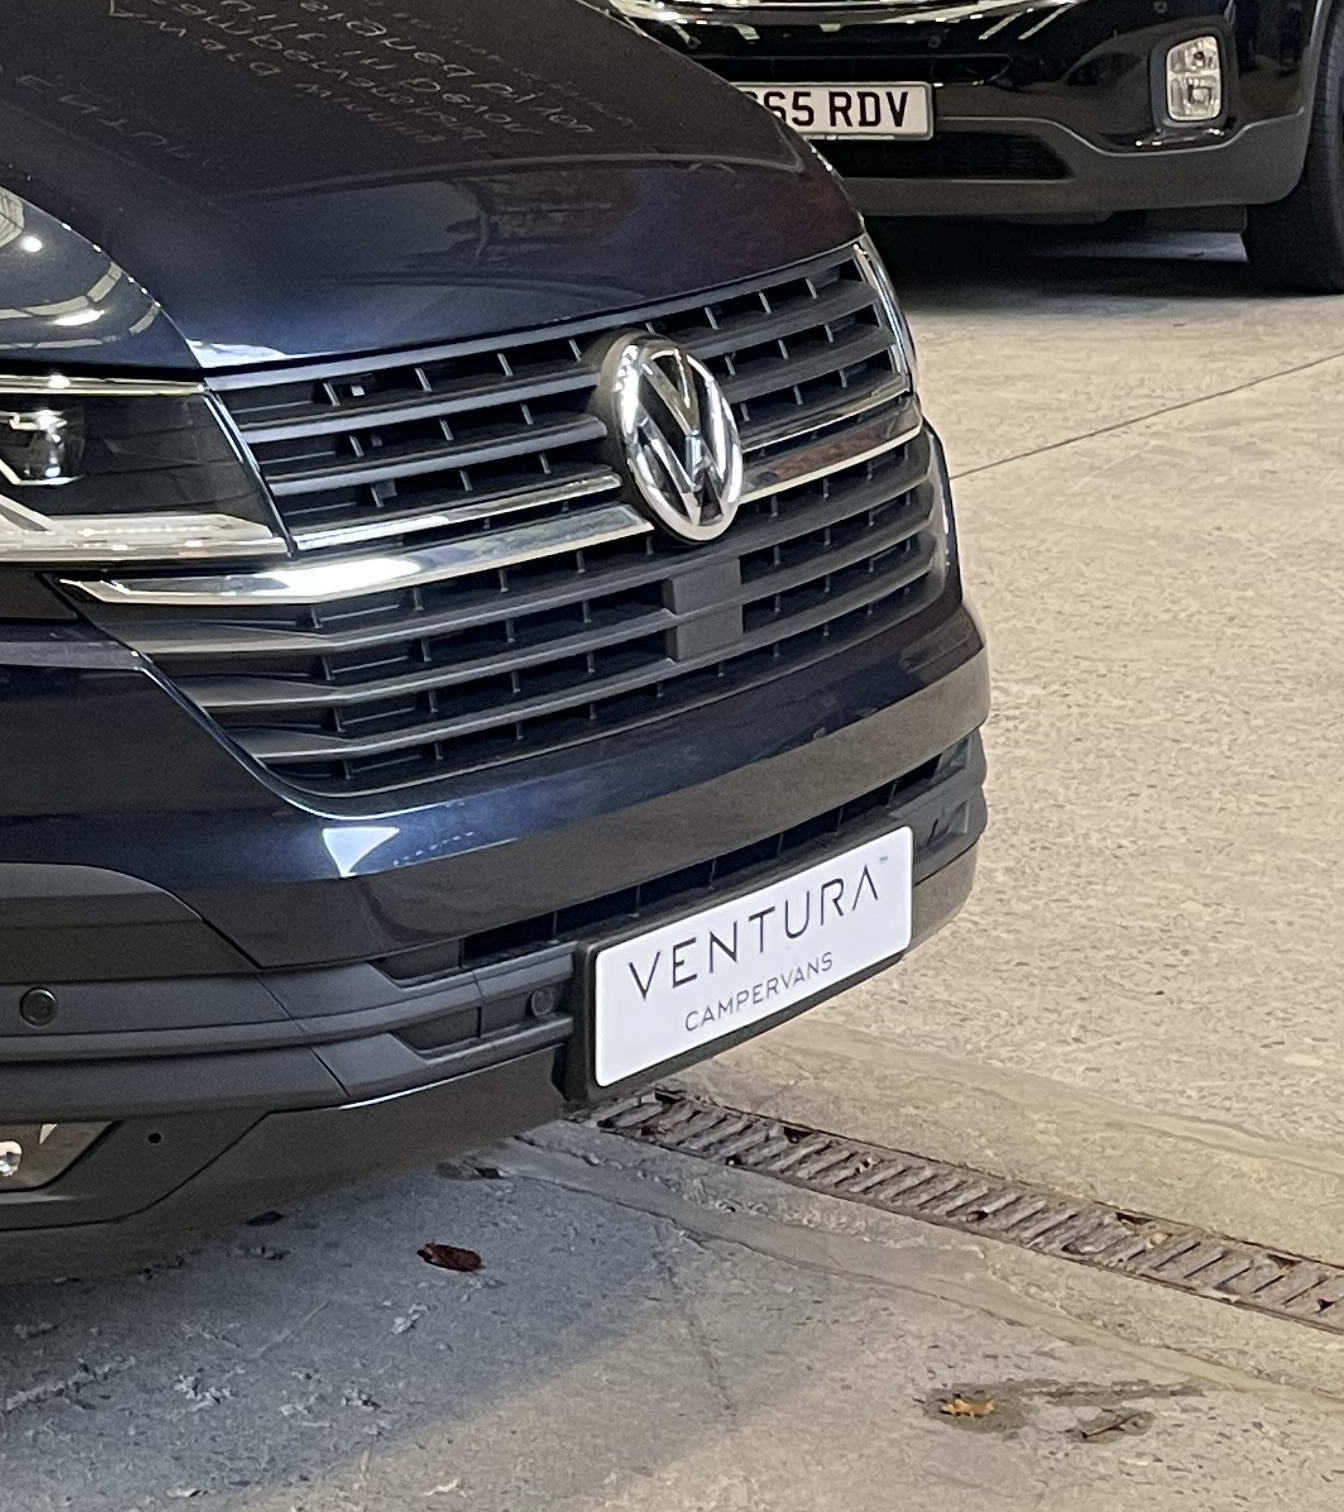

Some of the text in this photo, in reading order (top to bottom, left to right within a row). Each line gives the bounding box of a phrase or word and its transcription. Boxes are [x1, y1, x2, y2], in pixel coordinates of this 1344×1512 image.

[743, 90, 909, 128] 65 RDV
[628, 864, 879, 1002] VENTURA
[684, 951, 834, 1032] CAMPERVANS
